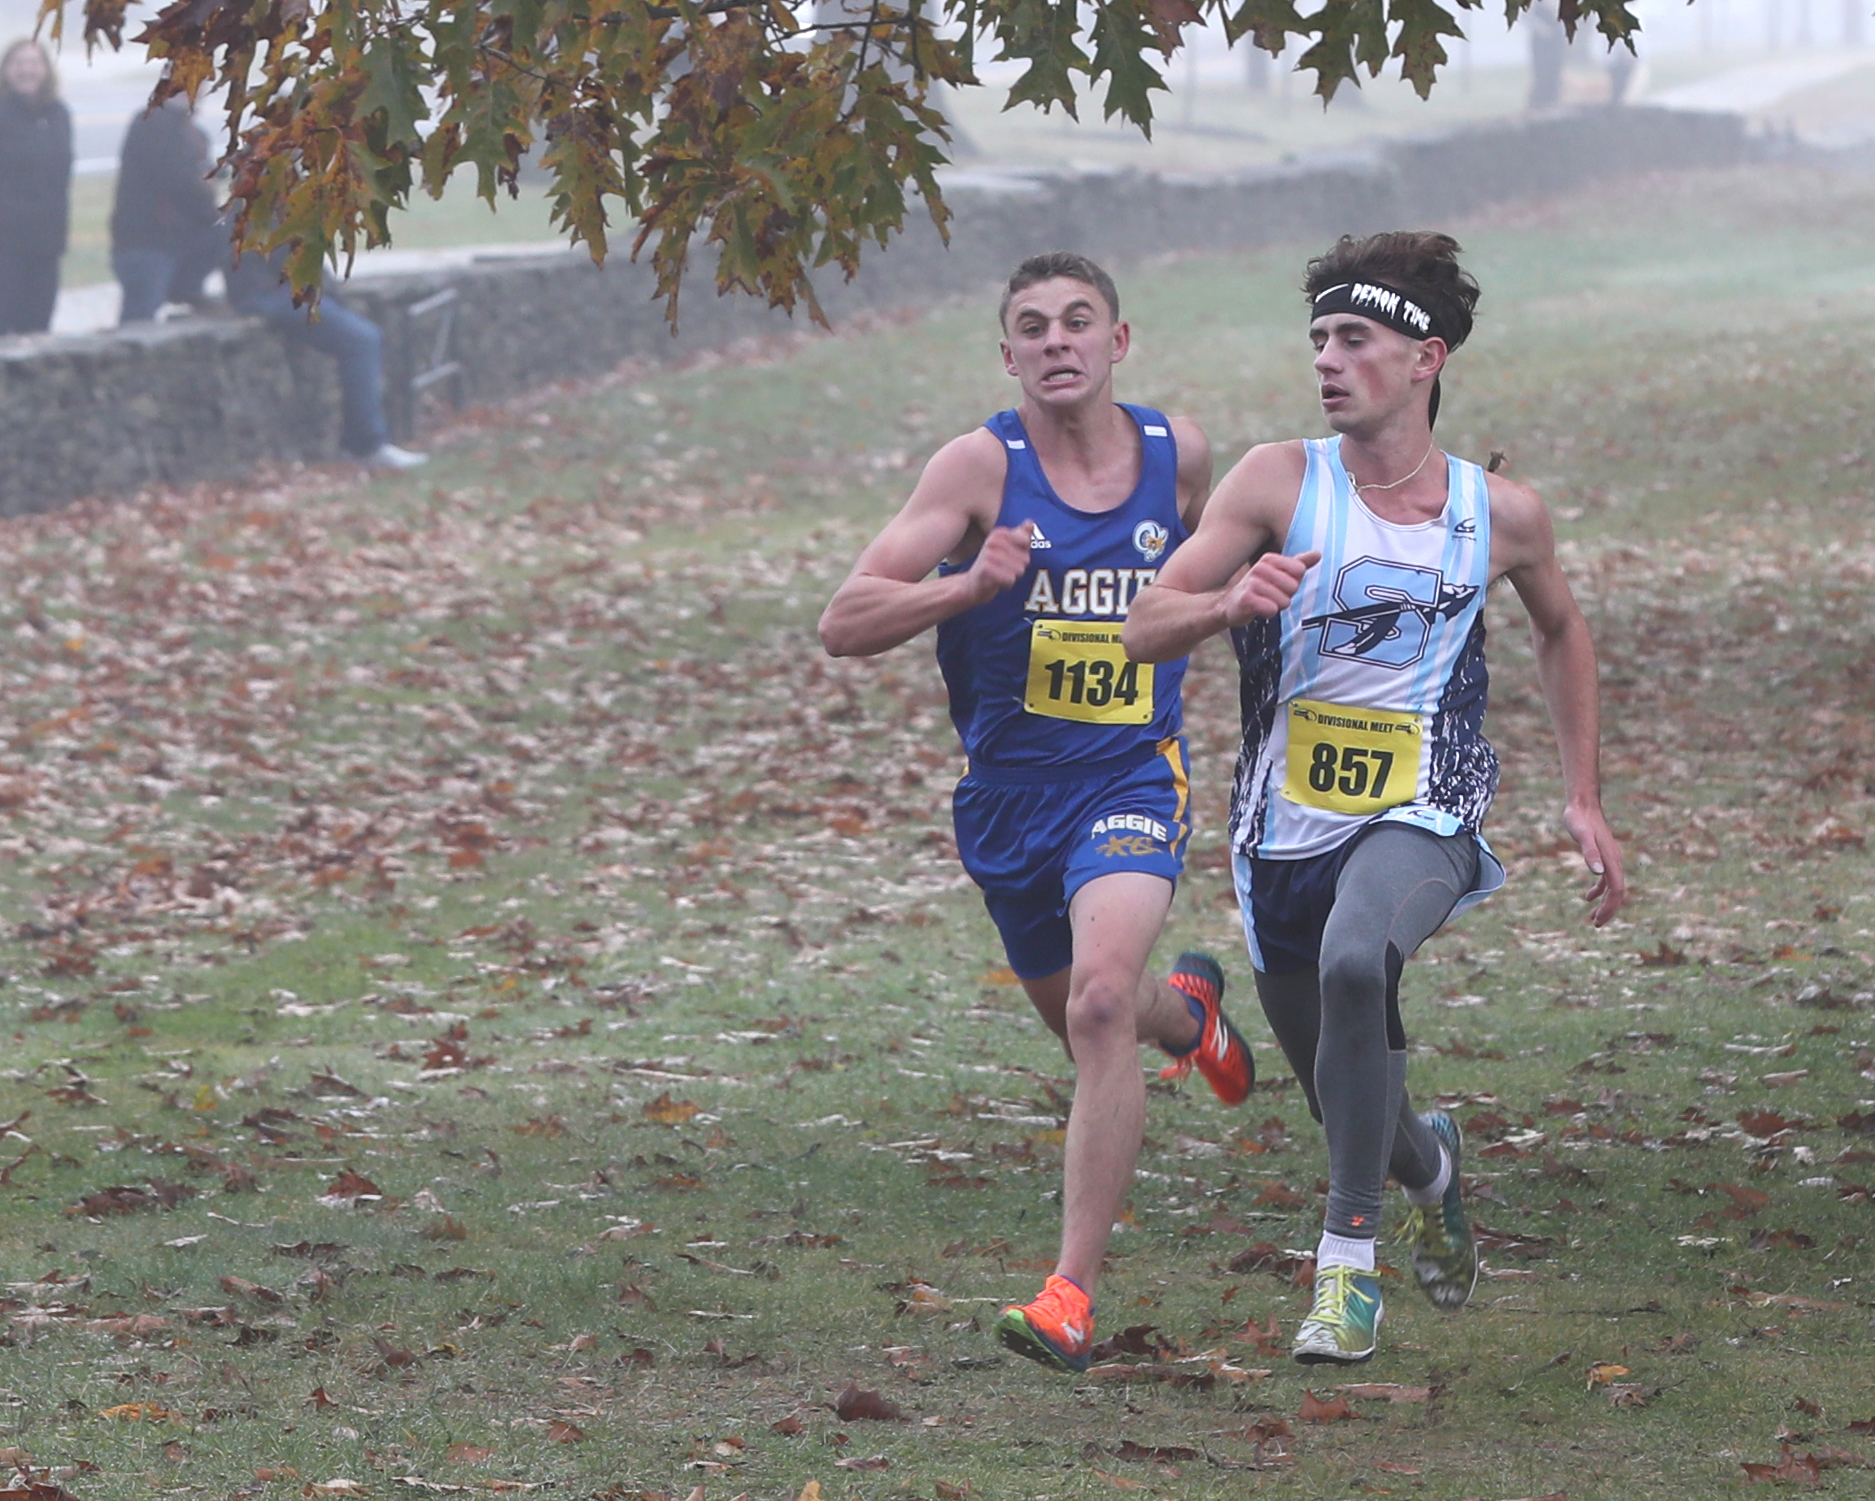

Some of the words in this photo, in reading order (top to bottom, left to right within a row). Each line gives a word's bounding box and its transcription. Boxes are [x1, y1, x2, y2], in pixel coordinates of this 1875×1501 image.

[1351, 283, 1401, 319] DEMON
[1403, 301, 1432, 333] TIME
[1062, 632, 1110, 643] DIVISIONAL
[1045, 659, 1138, 707] 1134
[1317, 713, 1369, 732] DIVISIONAL
[1369, 721, 1395, 733] MEET
[1309, 742, 1394, 799] 857
[1091, 814, 1167, 842] AGGIE
